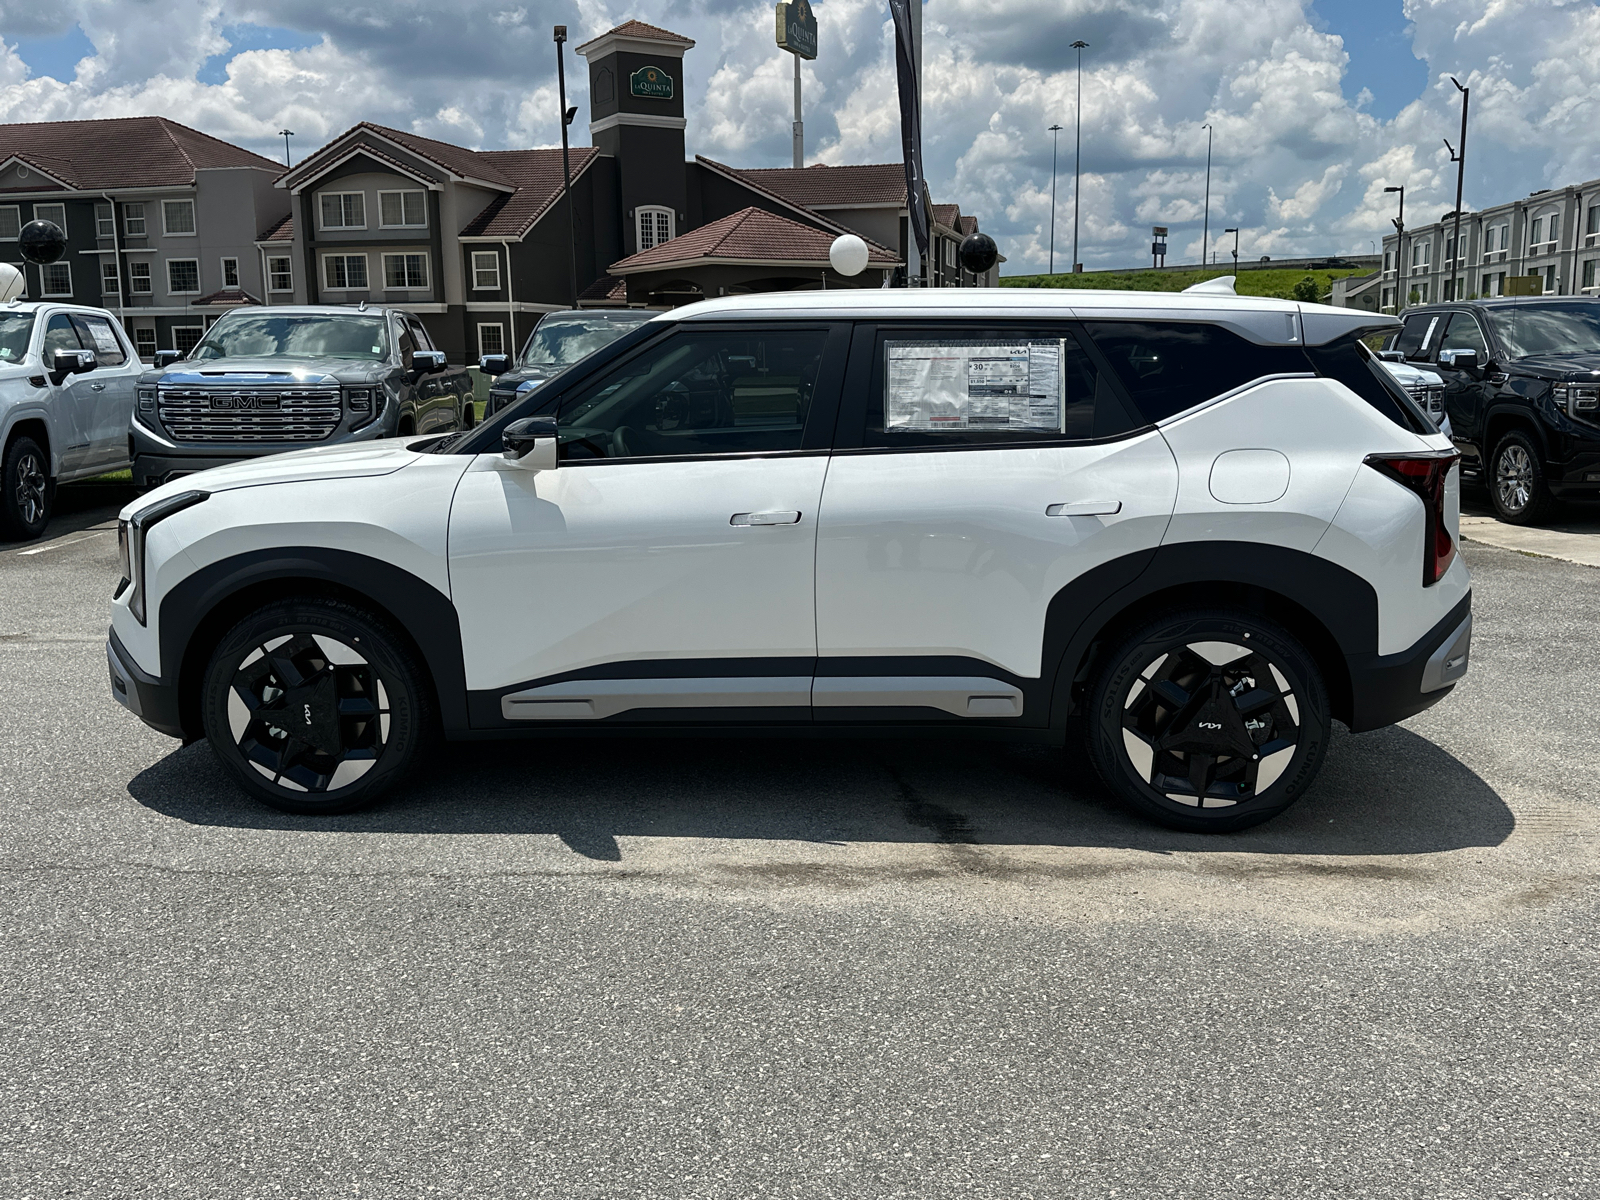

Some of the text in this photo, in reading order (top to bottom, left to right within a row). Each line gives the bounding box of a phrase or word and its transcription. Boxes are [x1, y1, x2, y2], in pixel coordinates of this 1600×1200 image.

[792, 22, 817, 46] QUINTA
[640, 81, 671, 92] QUINTA
[212, 396, 279, 409] GMC
[1103, 664, 1130, 719] SOLUS
[304, 704, 312, 725] KIA
[395, 696, 408, 752] KUMHO
[1198, 721, 1222, 730] KIA
[1285, 741, 1319, 794] KUMHO
